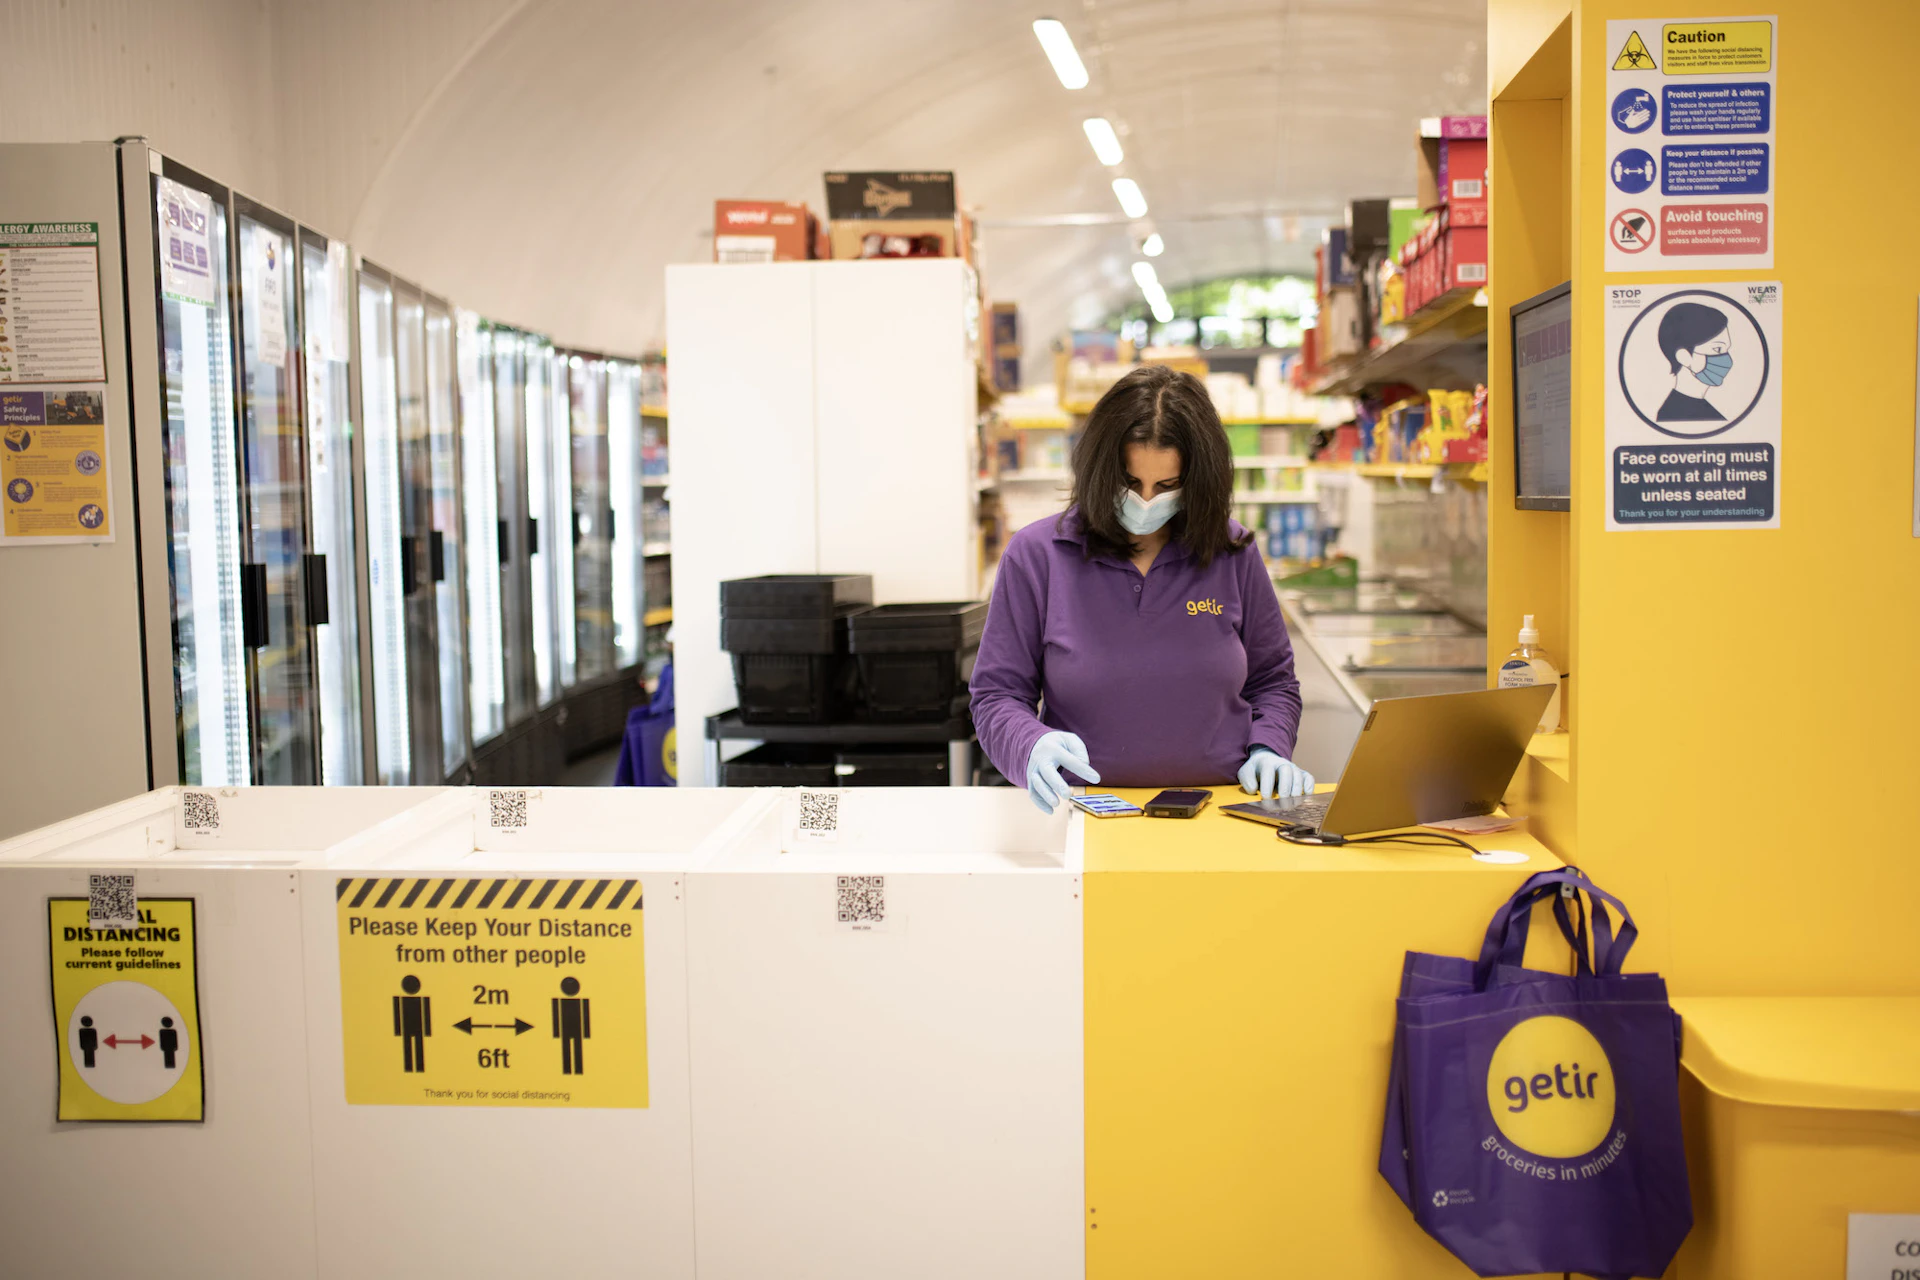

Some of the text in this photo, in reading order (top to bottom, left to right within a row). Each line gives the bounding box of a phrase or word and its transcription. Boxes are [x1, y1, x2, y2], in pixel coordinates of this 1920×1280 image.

[1668, 30, 1725, 43] Caution
[1698, 90, 1729, 99] yourself
[1666, 209, 1764, 223] Avoid touching
[33, 223, 91, 233] AWARENESS
[1612, 289, 1641, 298] STOP
[3, 395, 22, 405] getir
[4, 414, 40, 422] Principles
[1620, 450, 1768, 466] Face covering must
[1620, 469, 1767, 483] be worn at all times
[1641, 487, 1746, 502] unless seated
[1702, 508, 1765, 517] understanding
[1186, 598, 1223, 616] getir
[64, 928, 180, 942] DISTANCING
[349, 917, 632, 939] Please Keep Your Distance
[82, 948, 164, 957] Please follow
[396, 945, 586, 967] from other people
[66, 959, 181, 971] current guidelines
[473, 985, 509, 1005] 2m
[478, 1048, 509, 1068] 6ft
[424, 1089, 570, 1101] Thank you for social distancing
[1504, 1063, 1598, 1113] getir
[1481, 1129, 1627, 1180] groceries in minutes
